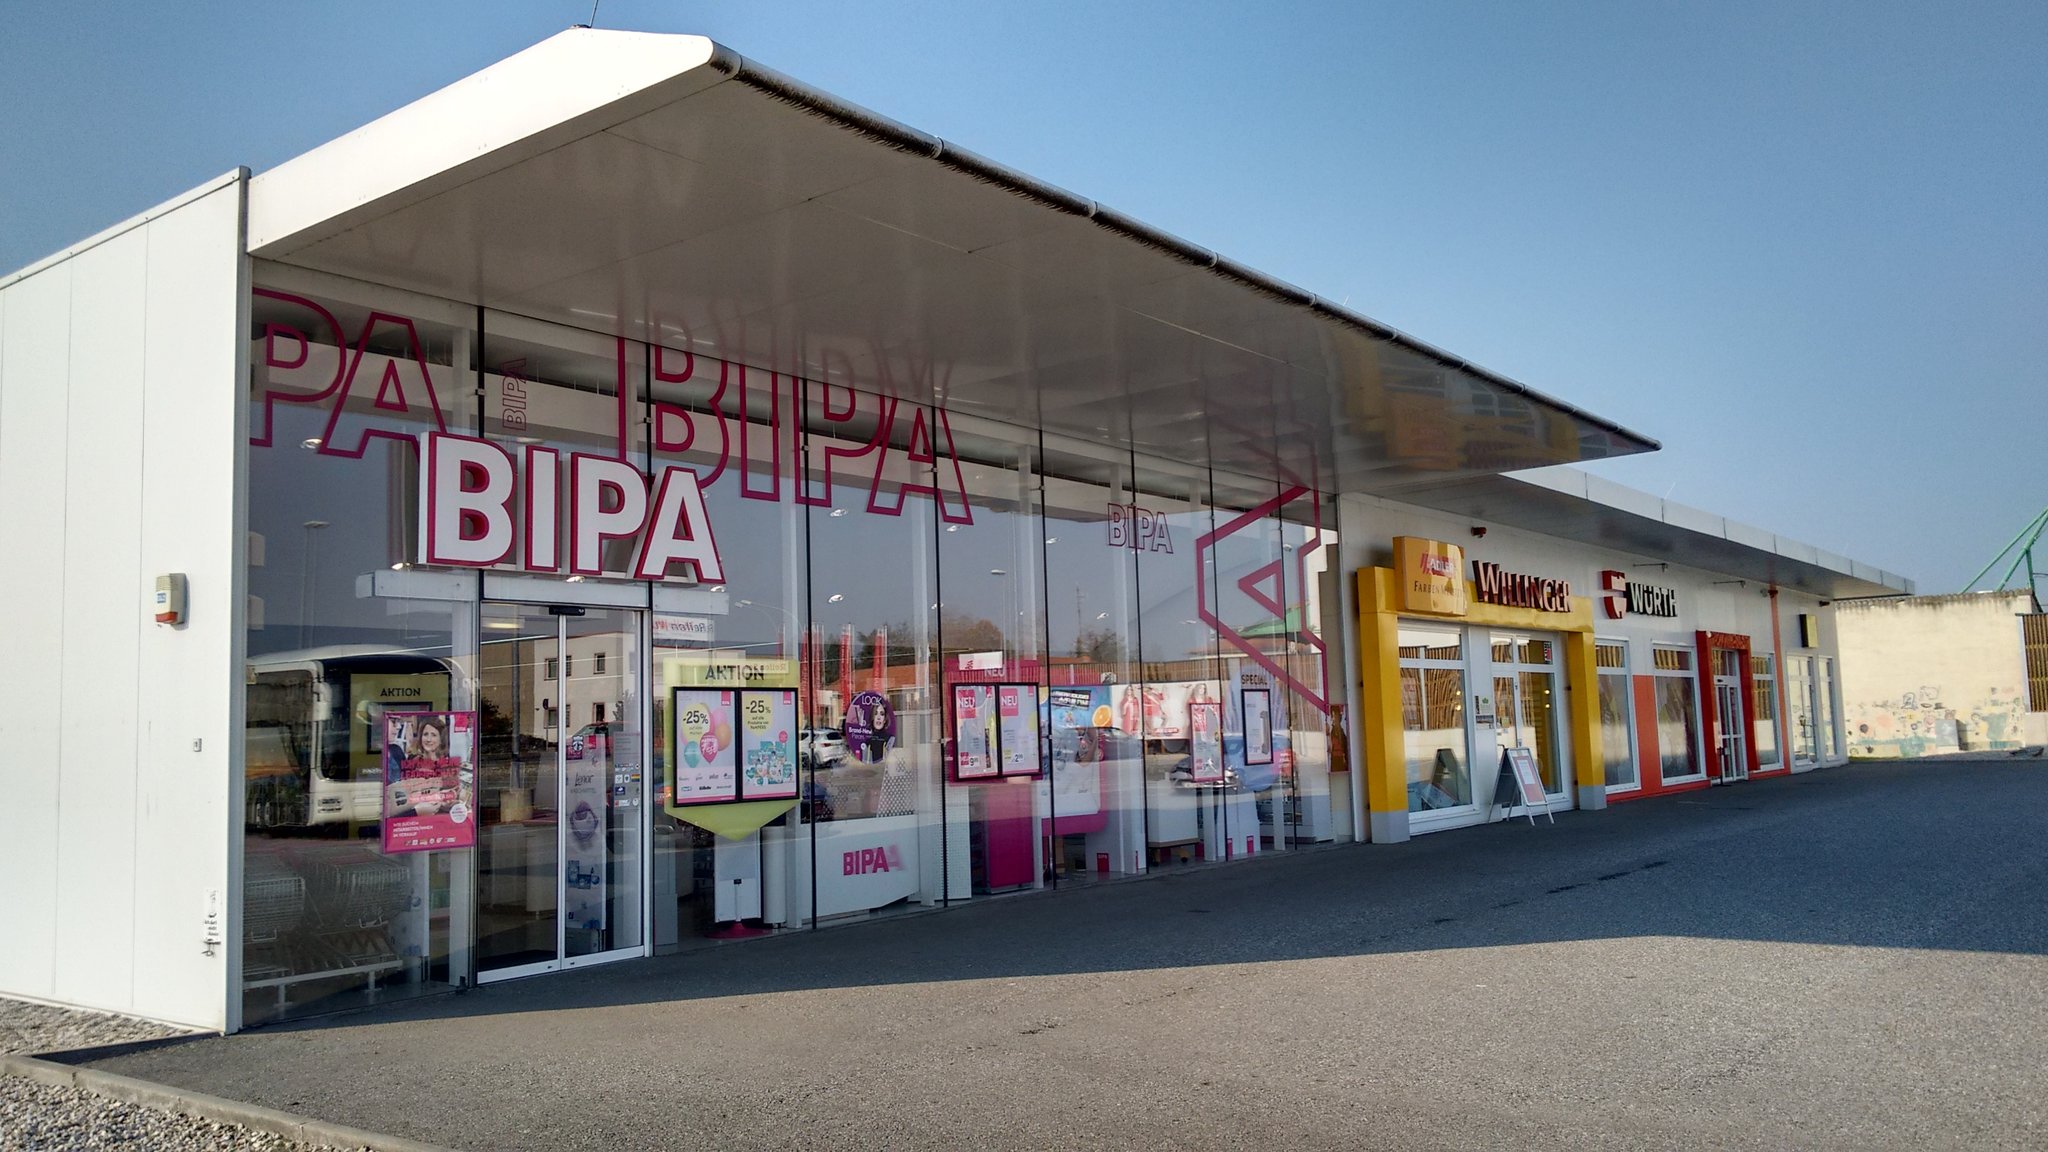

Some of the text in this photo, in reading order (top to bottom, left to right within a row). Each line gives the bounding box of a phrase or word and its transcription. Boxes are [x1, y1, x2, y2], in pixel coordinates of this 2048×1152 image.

[502, 357, 527, 431] BIPA
[418, 431, 727, 585] BIPA
[1107, 502, 1174, 554] BIPA
[1472, 560, 1571, 613] WILLINGER
[1626, 581, 1678, 617] WÜRTH
[705, 664, 765, 681] AKTION
[1241, 674, 1268, 686] SPECIAL
[380, 687, 421, 697] AKTION
[745, 700, 772, 714] -25%
[861, 695, 882, 706] LOOK
[959, 696, 976, 708] NEU
[1001, 695, 1018, 706] NEU
[682, 710, 709, 725] -25%
[843, 847, 889, 876] BIPA
